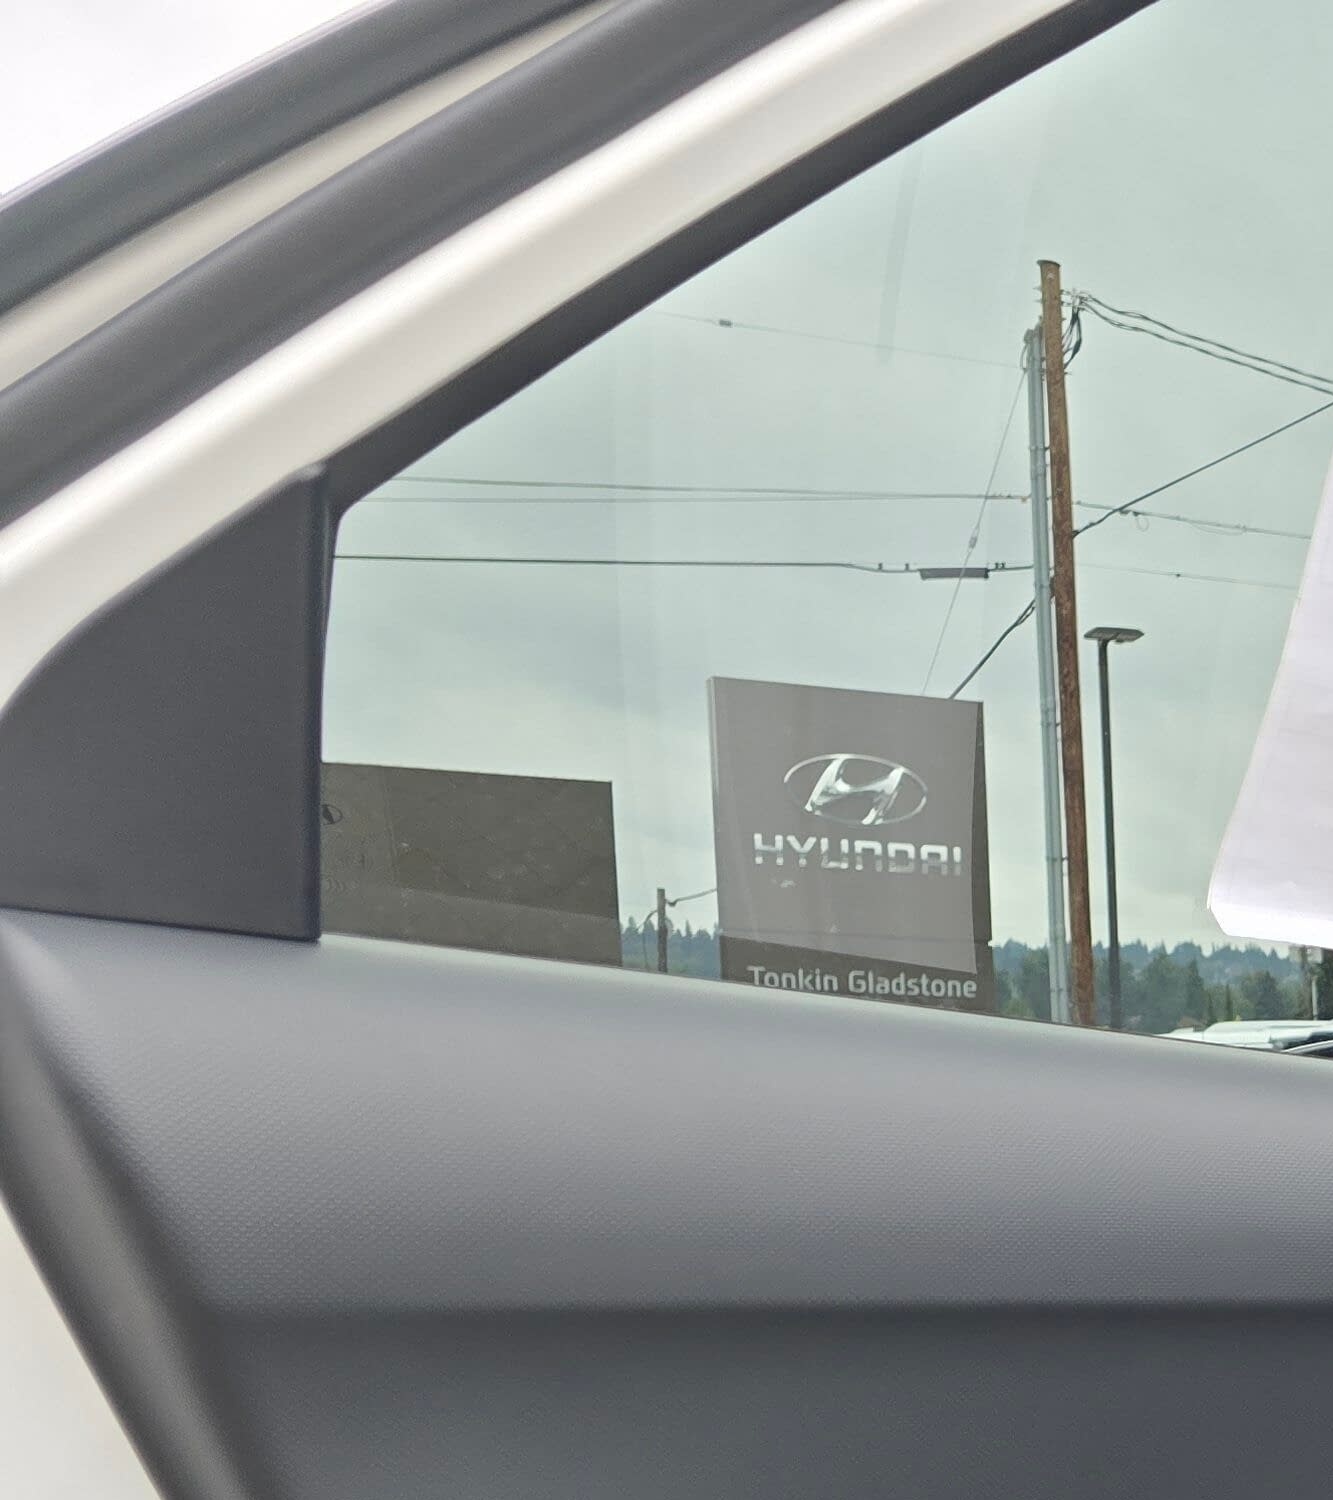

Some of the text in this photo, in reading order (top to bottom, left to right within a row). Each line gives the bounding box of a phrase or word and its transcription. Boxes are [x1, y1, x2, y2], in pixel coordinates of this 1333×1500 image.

[753, 832, 962, 876] HYUNDAI
[747, 965, 978, 999] Tonkin Gladstone
